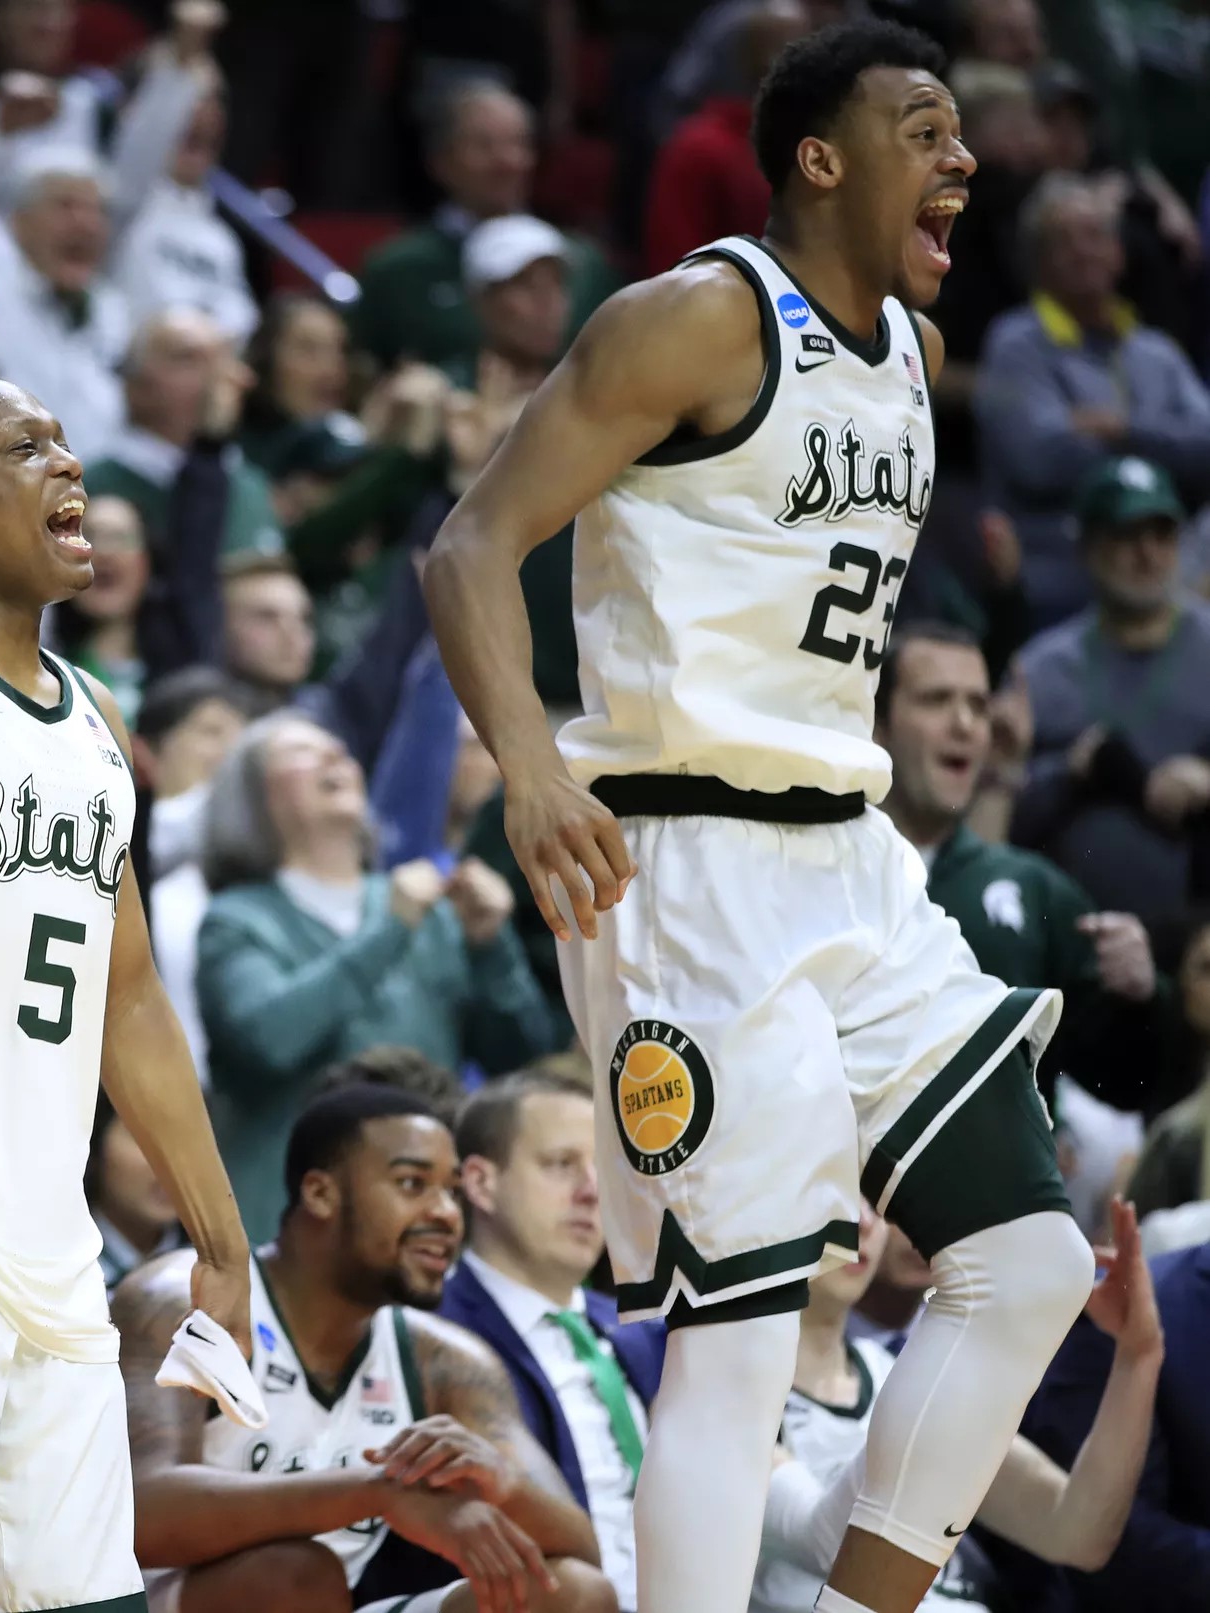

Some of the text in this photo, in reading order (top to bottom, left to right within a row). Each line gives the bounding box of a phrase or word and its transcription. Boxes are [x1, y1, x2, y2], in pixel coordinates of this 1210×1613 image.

[783, 307, 809, 320] NCAA
[798, 541, 907, 671] 23
[17, 913, 86, 1045] 5
[612, 1022, 689, 1071] MICHIGAN
[624, 1079, 684, 1115] SPARTANS
[639, 1142, 689, 1173] STATE
